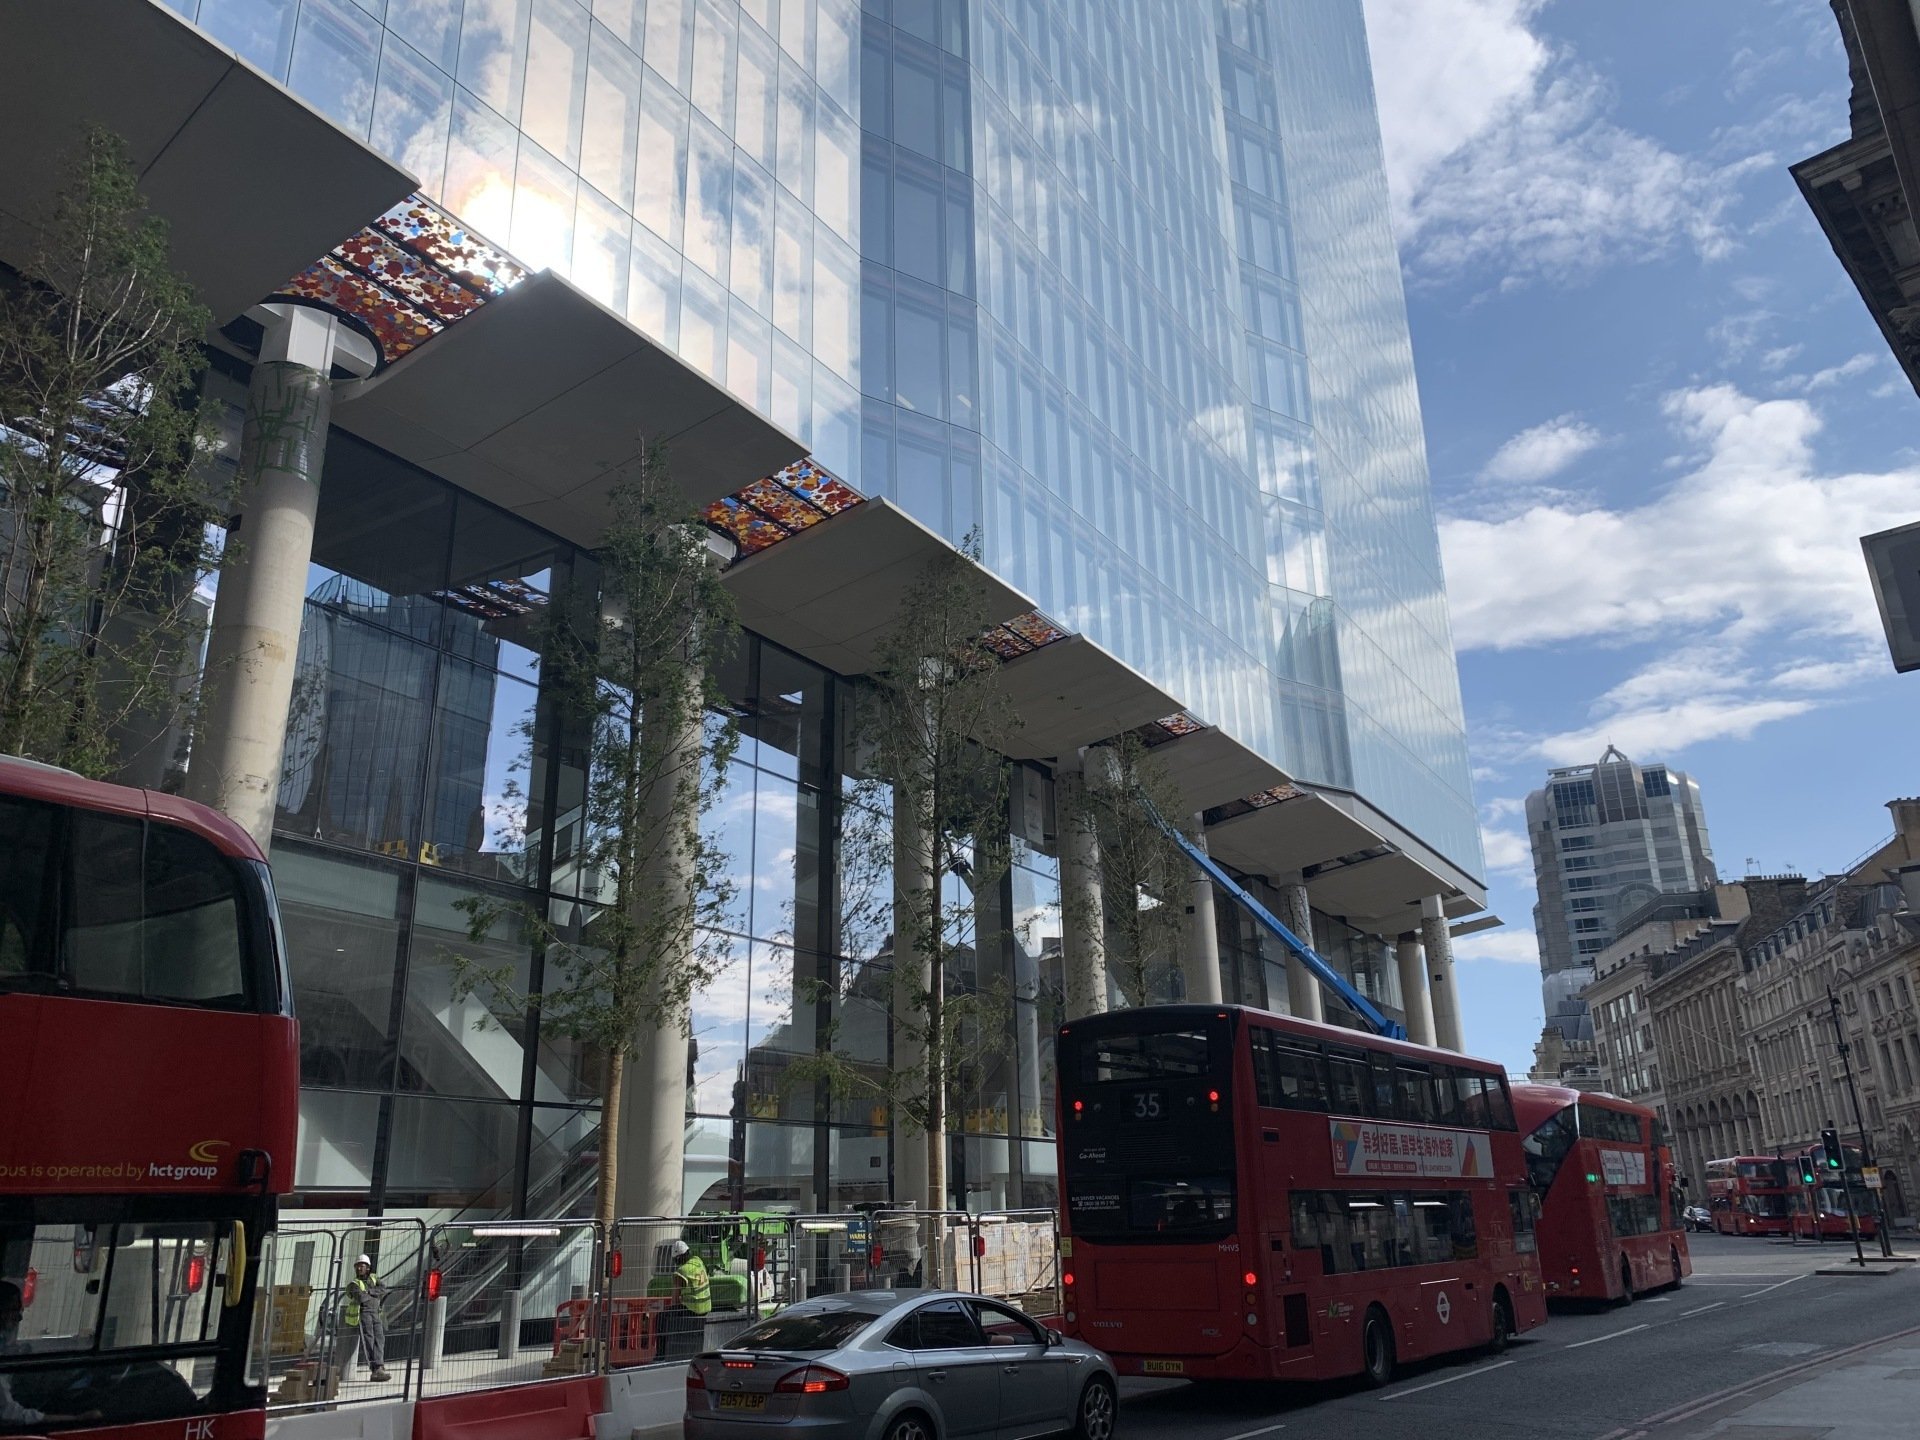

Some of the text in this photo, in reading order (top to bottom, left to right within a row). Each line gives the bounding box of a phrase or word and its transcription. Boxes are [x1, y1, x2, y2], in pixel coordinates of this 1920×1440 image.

[1134, 1093, 1160, 1118] 35
[1079, 1152, 1106, 1160] Go-Ahead
[31, 1162, 44, 1177] is
[46, 1162, 123, 1182] operated
[127, 1161, 146, 1181] by
[1092, 1320, 1123, 1328] VOLVO
[745, 1395, 764, 1408] LBP
[185, 1418, 216, 1440] HK
